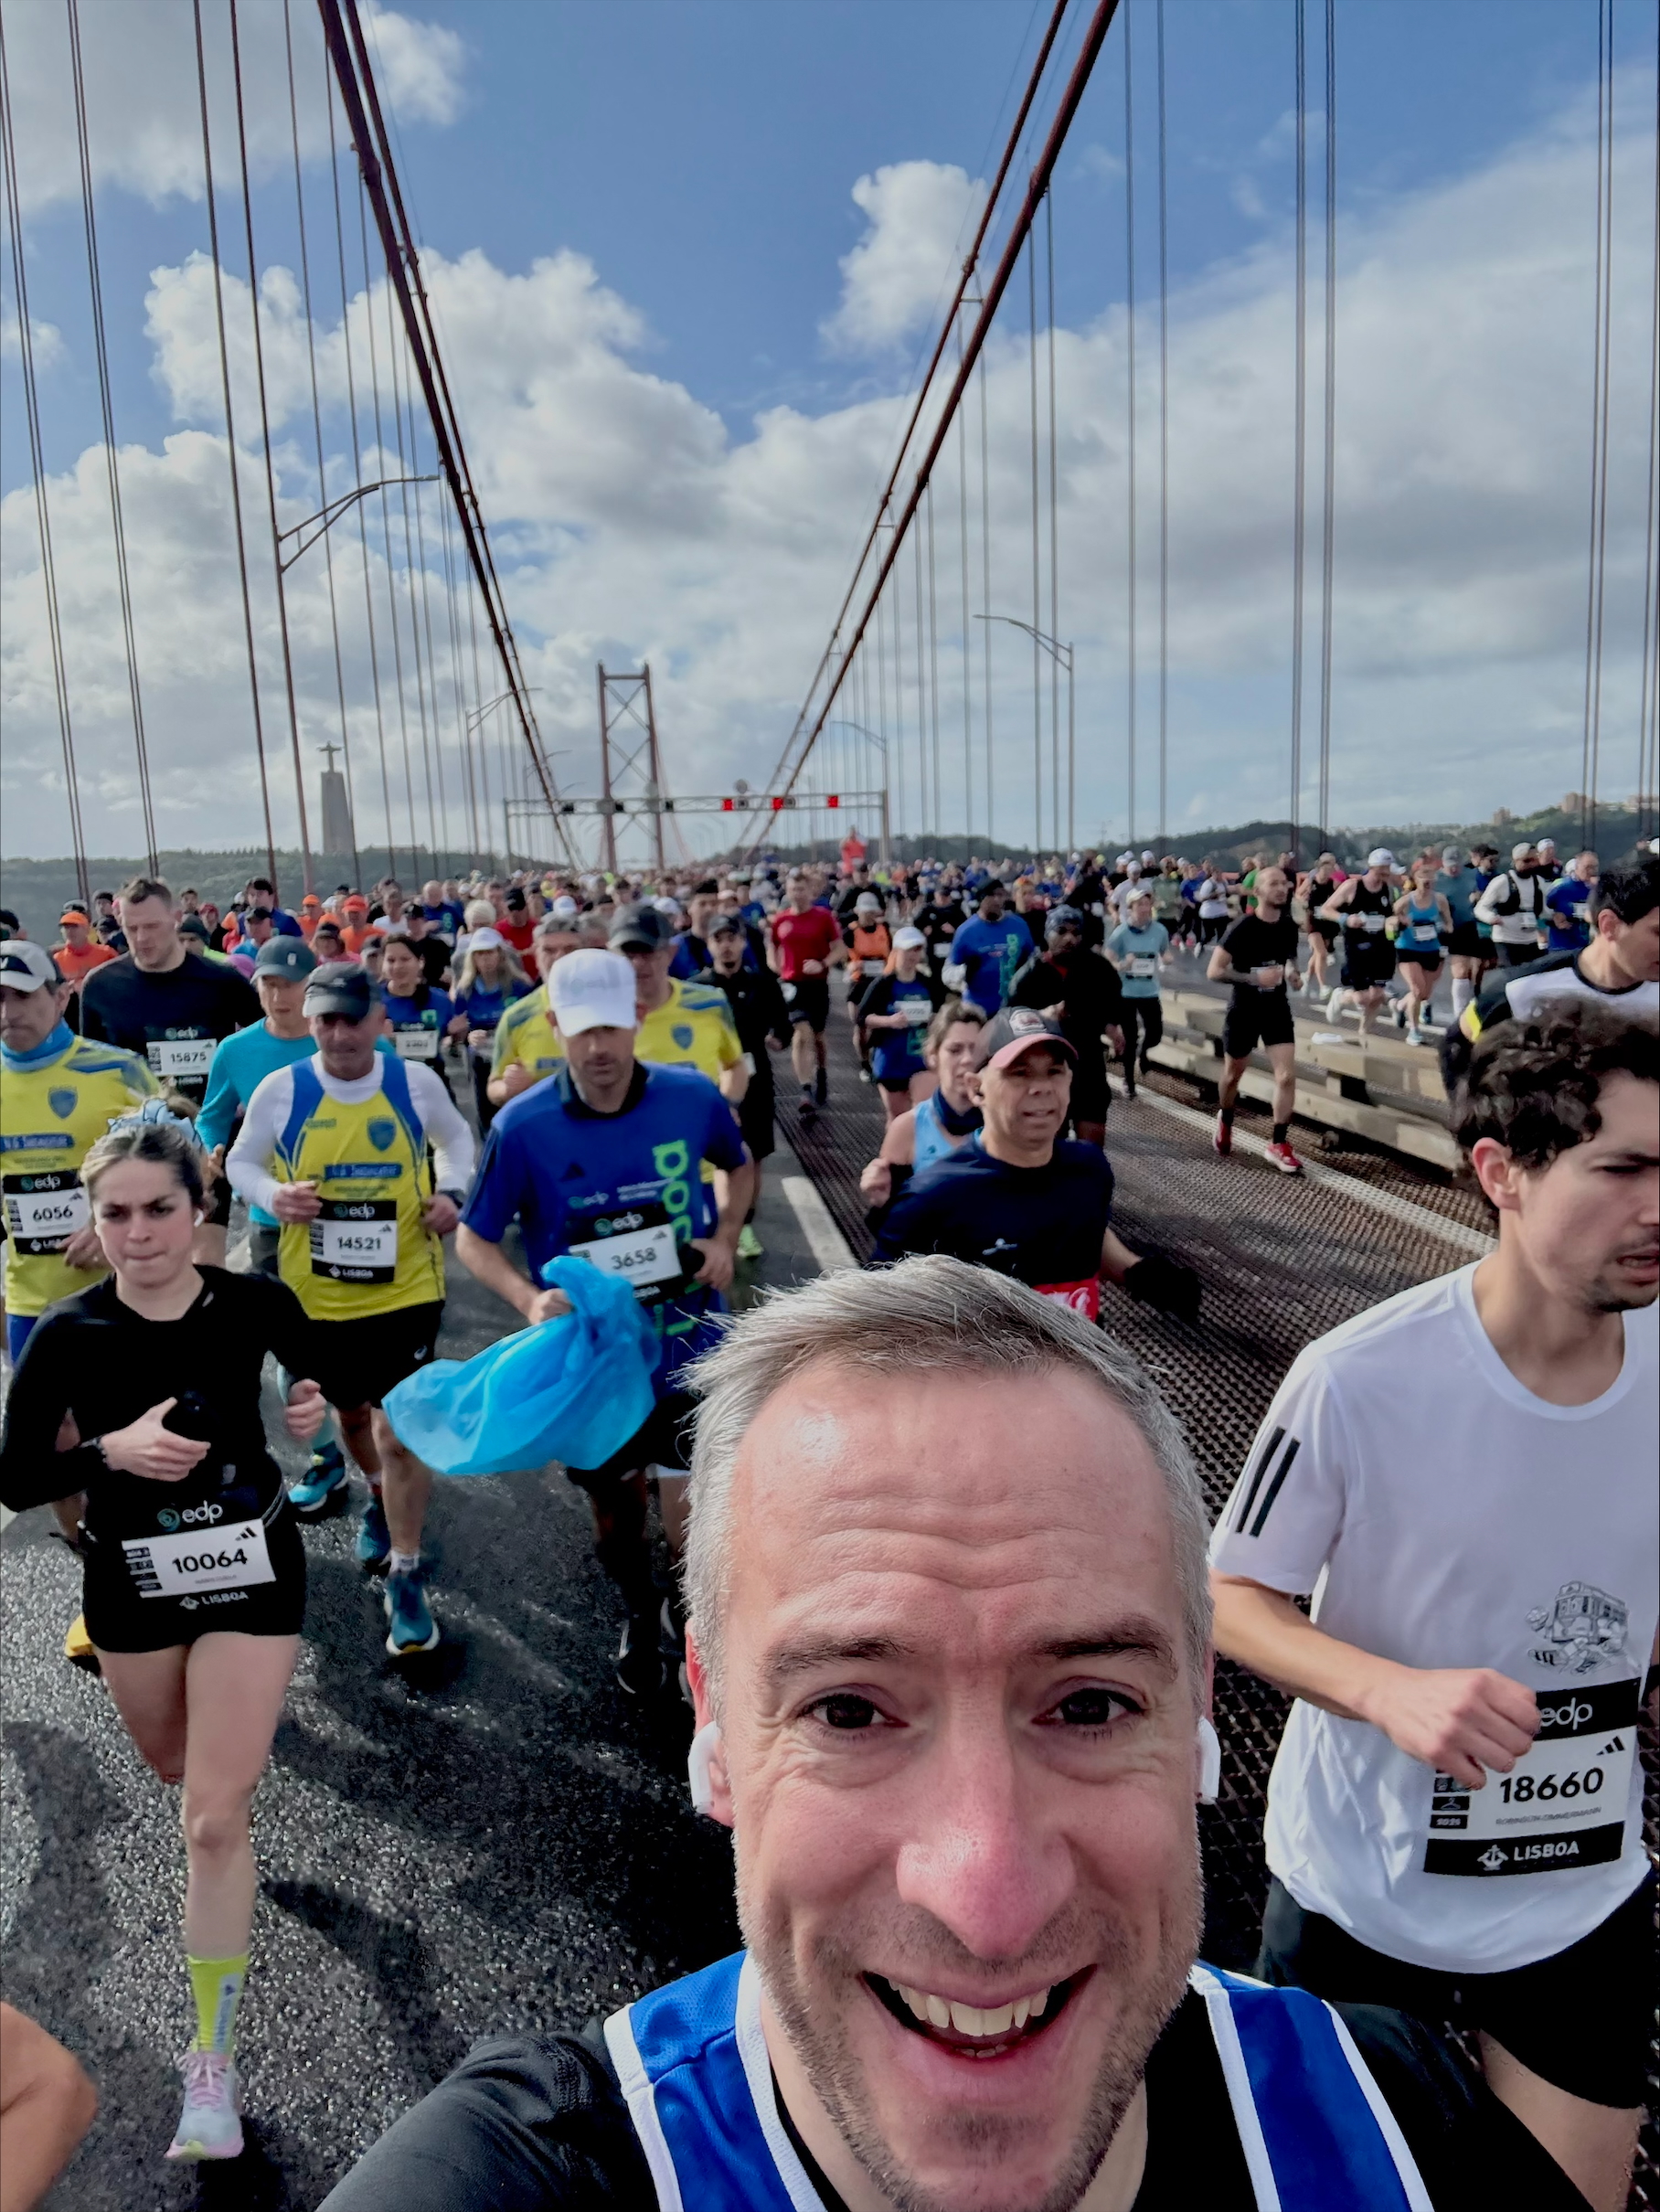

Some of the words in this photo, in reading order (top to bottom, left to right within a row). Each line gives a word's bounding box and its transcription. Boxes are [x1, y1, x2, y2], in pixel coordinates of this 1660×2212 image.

[170, 1051, 207, 1063] 15875
[34, 1174, 61, 1189] edp
[33, 1206, 73, 1221] 6056
[348, 1202, 376, 1220] edp
[612, 1211, 644, 1230] edp
[337, 1237, 381, 1250] 14521
[611, 1247, 657, 1271] 3658
[182, 1500, 224, 1525] edp
[172, 1547, 248, 1574] 10064
[200, 1591, 249, 1605] LISBOA
[1539, 1697, 1593, 1730] edp
[1500, 1767, 1604, 1803] 18660
[1514, 1841, 1580, 1861] LISBOA
